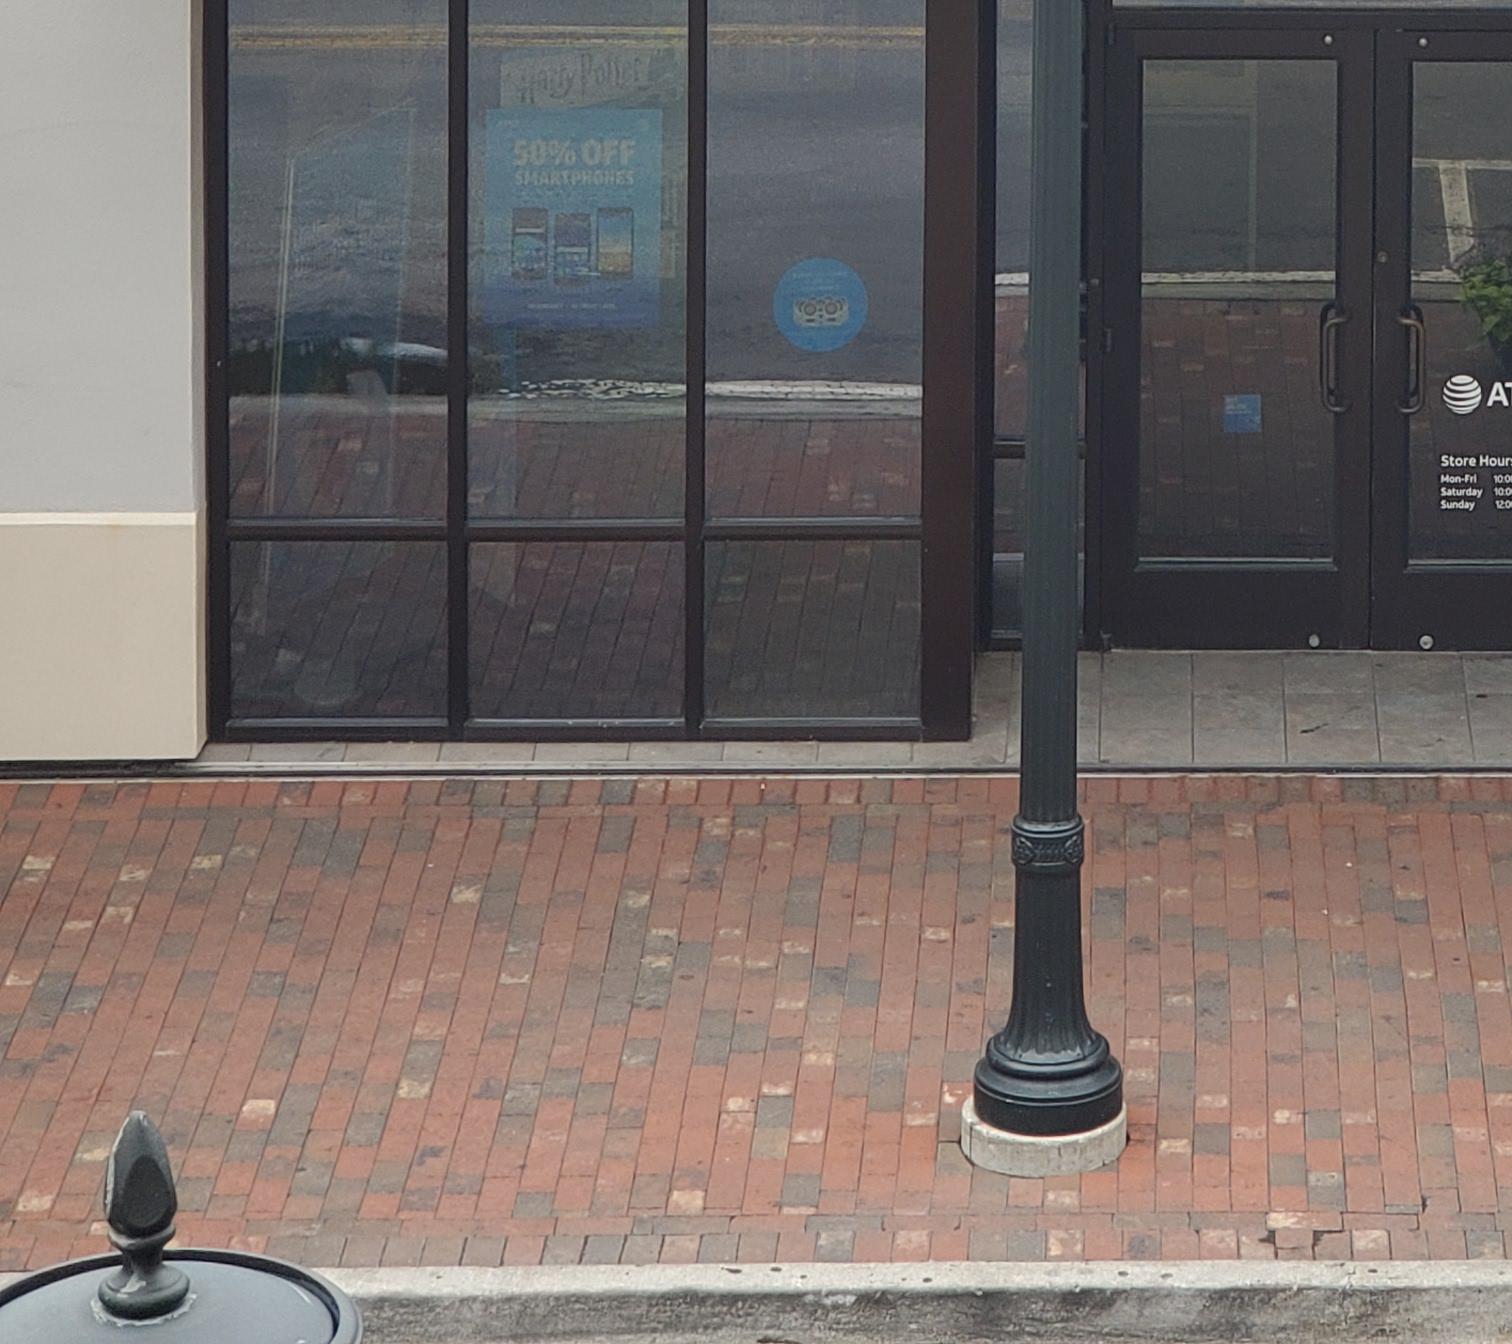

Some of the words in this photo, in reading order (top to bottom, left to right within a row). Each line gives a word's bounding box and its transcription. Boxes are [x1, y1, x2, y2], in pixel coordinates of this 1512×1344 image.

[513, 138, 576, 166] 50%
[581, 138, 636, 166] OFF
[514, 170, 635, 185] SMARTPHONES
[1440, 454, 1477, 467] Store
[1440, 473, 1478, 484] Mon-Fri
[1440, 486, 1483, 498] Saturday
[1440, 499, 1475, 511] Sunday
